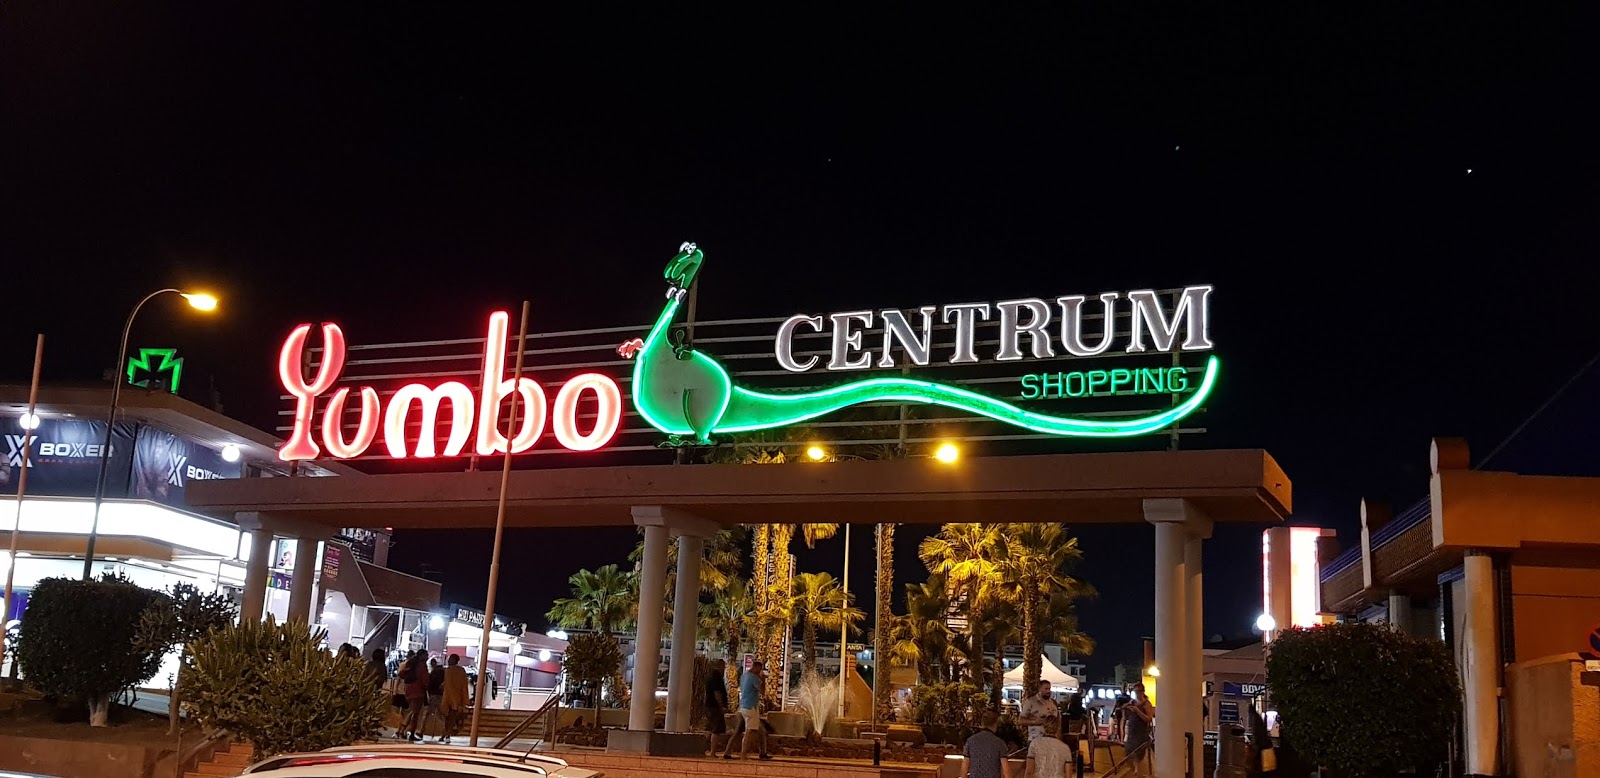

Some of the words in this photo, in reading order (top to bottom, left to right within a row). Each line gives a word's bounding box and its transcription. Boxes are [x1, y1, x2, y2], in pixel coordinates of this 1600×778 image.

[774, 285, 1214, 372] CENTRUM
[278, 311, 622, 461] Yumbo
[1020, 366, 1189, 400] SHOPPING
[1241, 684, 1266, 695] BBVA
